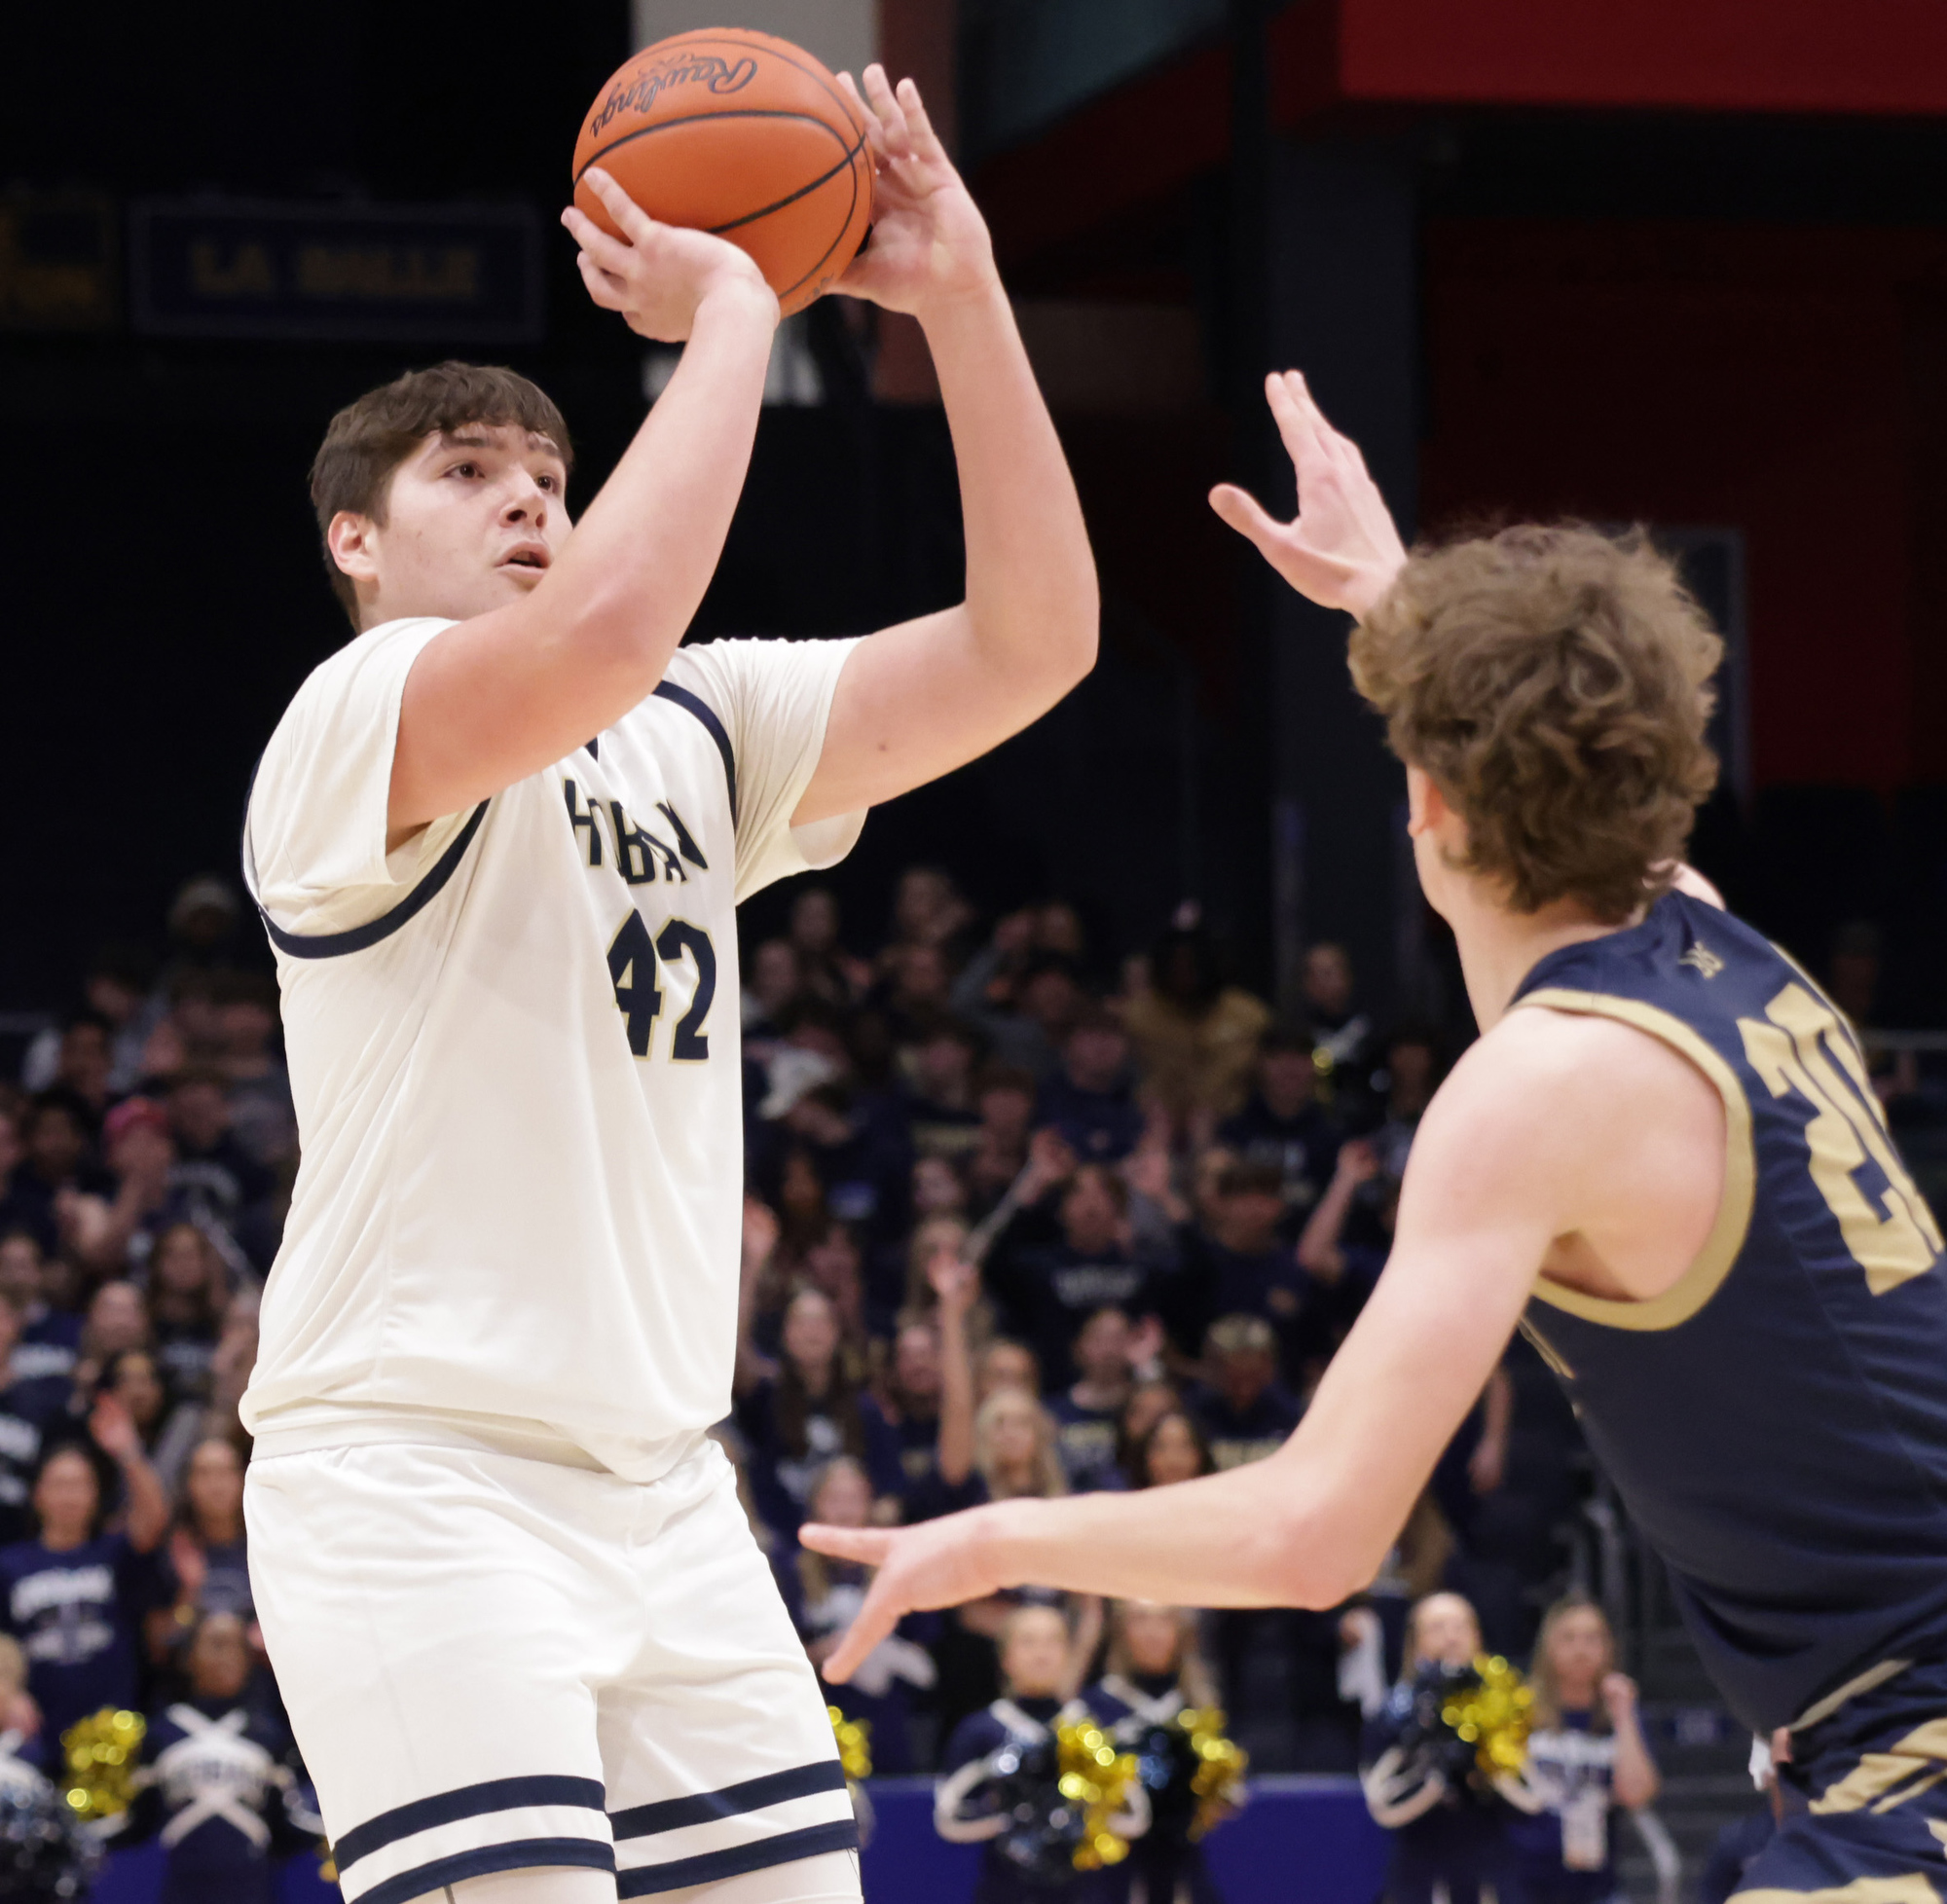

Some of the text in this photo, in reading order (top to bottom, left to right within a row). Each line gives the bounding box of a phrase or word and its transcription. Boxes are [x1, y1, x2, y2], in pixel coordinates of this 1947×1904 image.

[589, 55, 758, 138] Rawlings
[561, 776, 710, 887] HBAN
[605, 905, 717, 1065] 42
